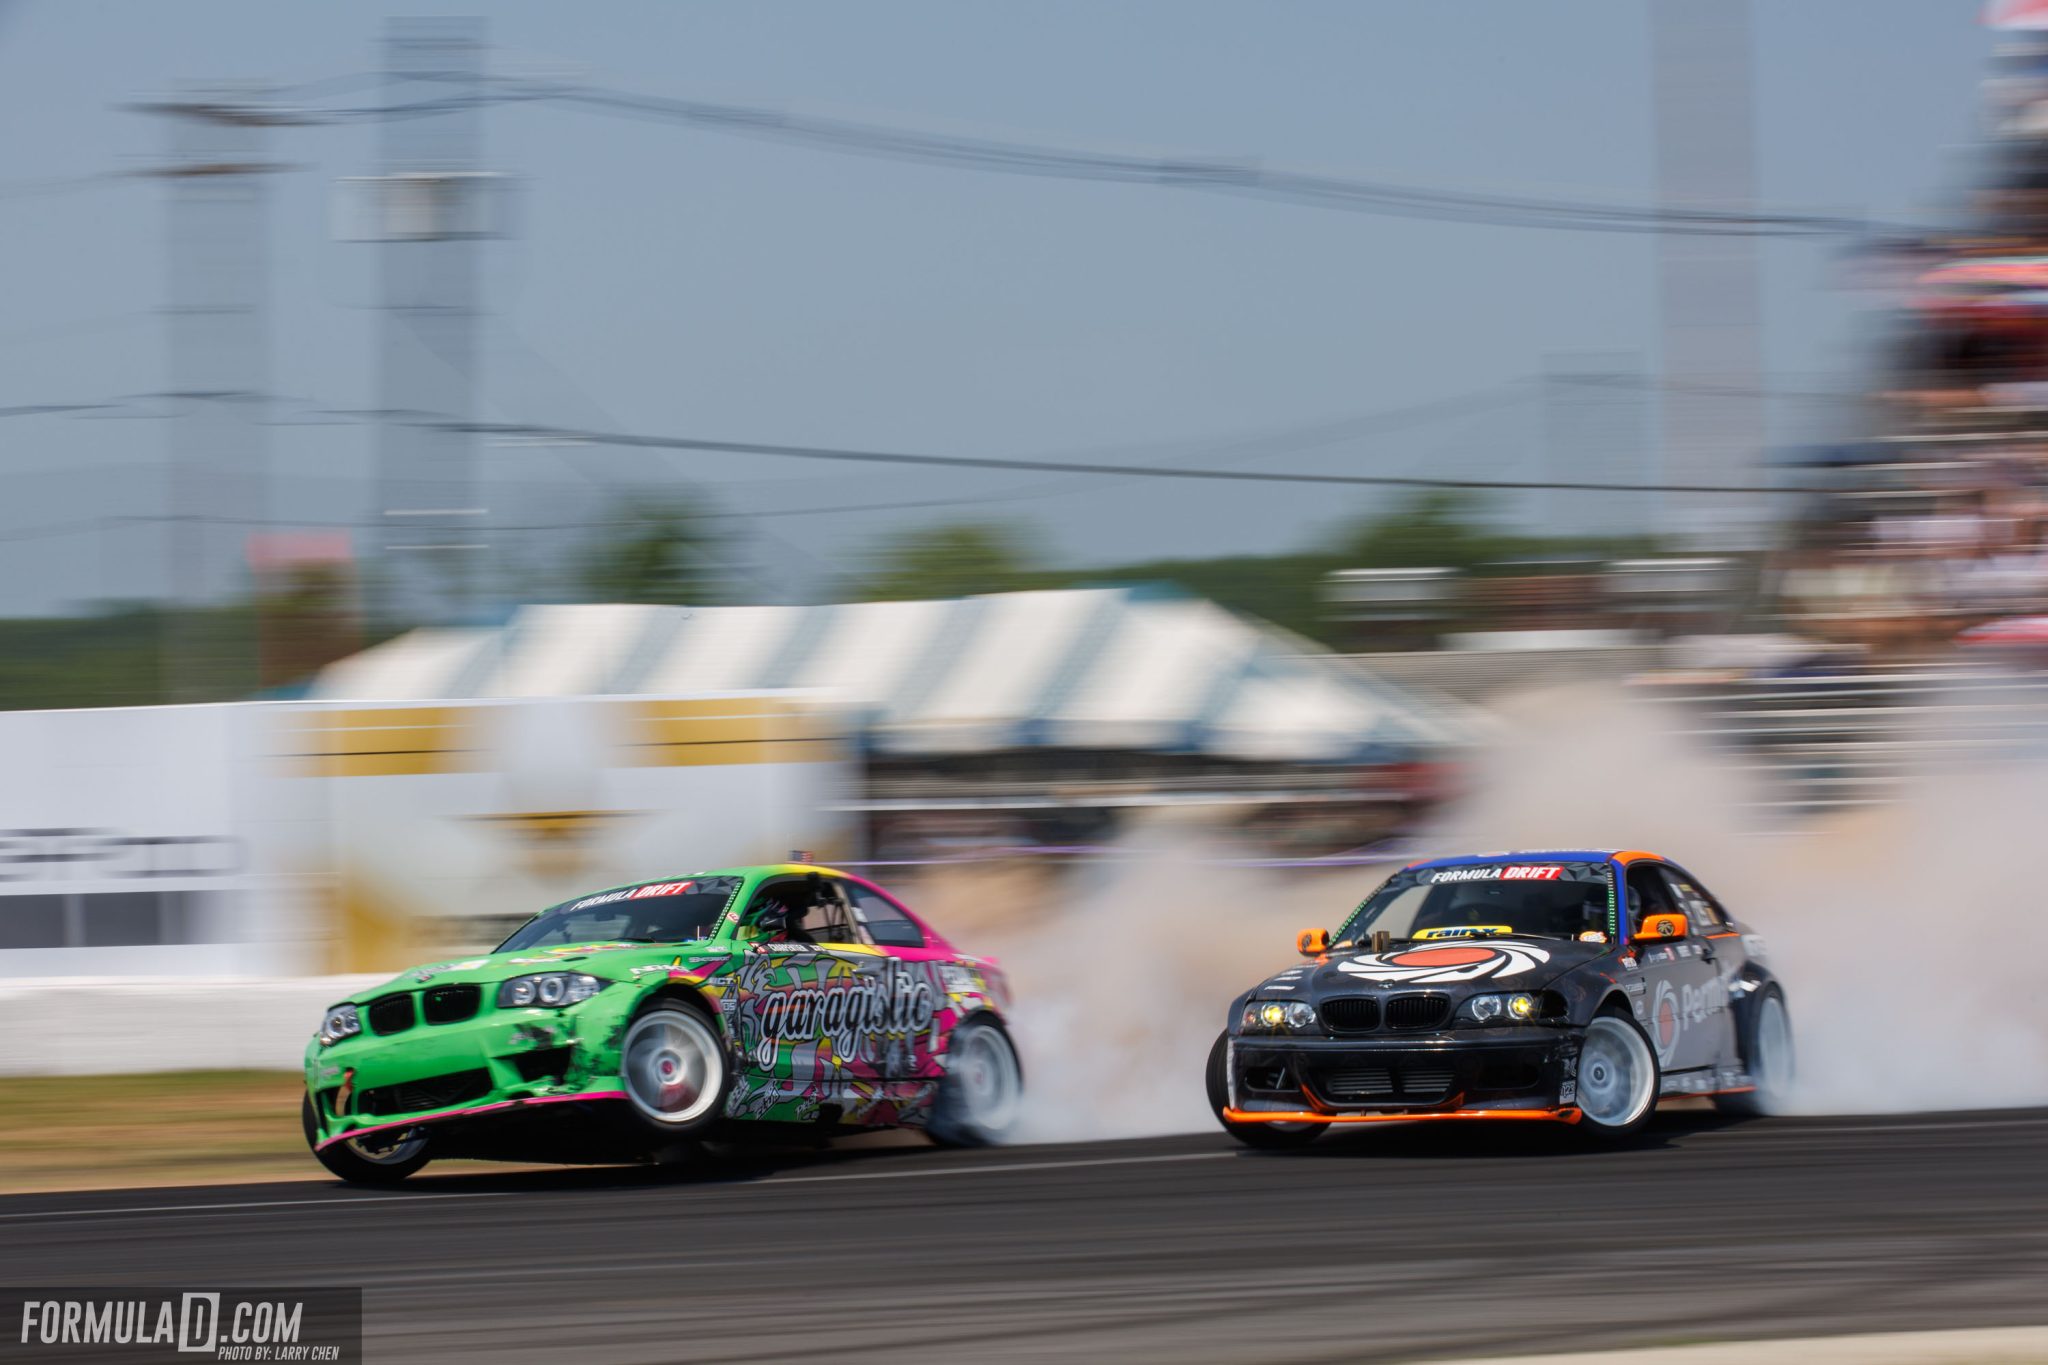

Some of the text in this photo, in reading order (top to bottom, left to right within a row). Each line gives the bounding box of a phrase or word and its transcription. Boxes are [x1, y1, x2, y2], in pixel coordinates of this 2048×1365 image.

[1430, 866, 1561, 883] FORMULA DRIFT
[570, 881, 691, 912] FORMULA DRIFT
